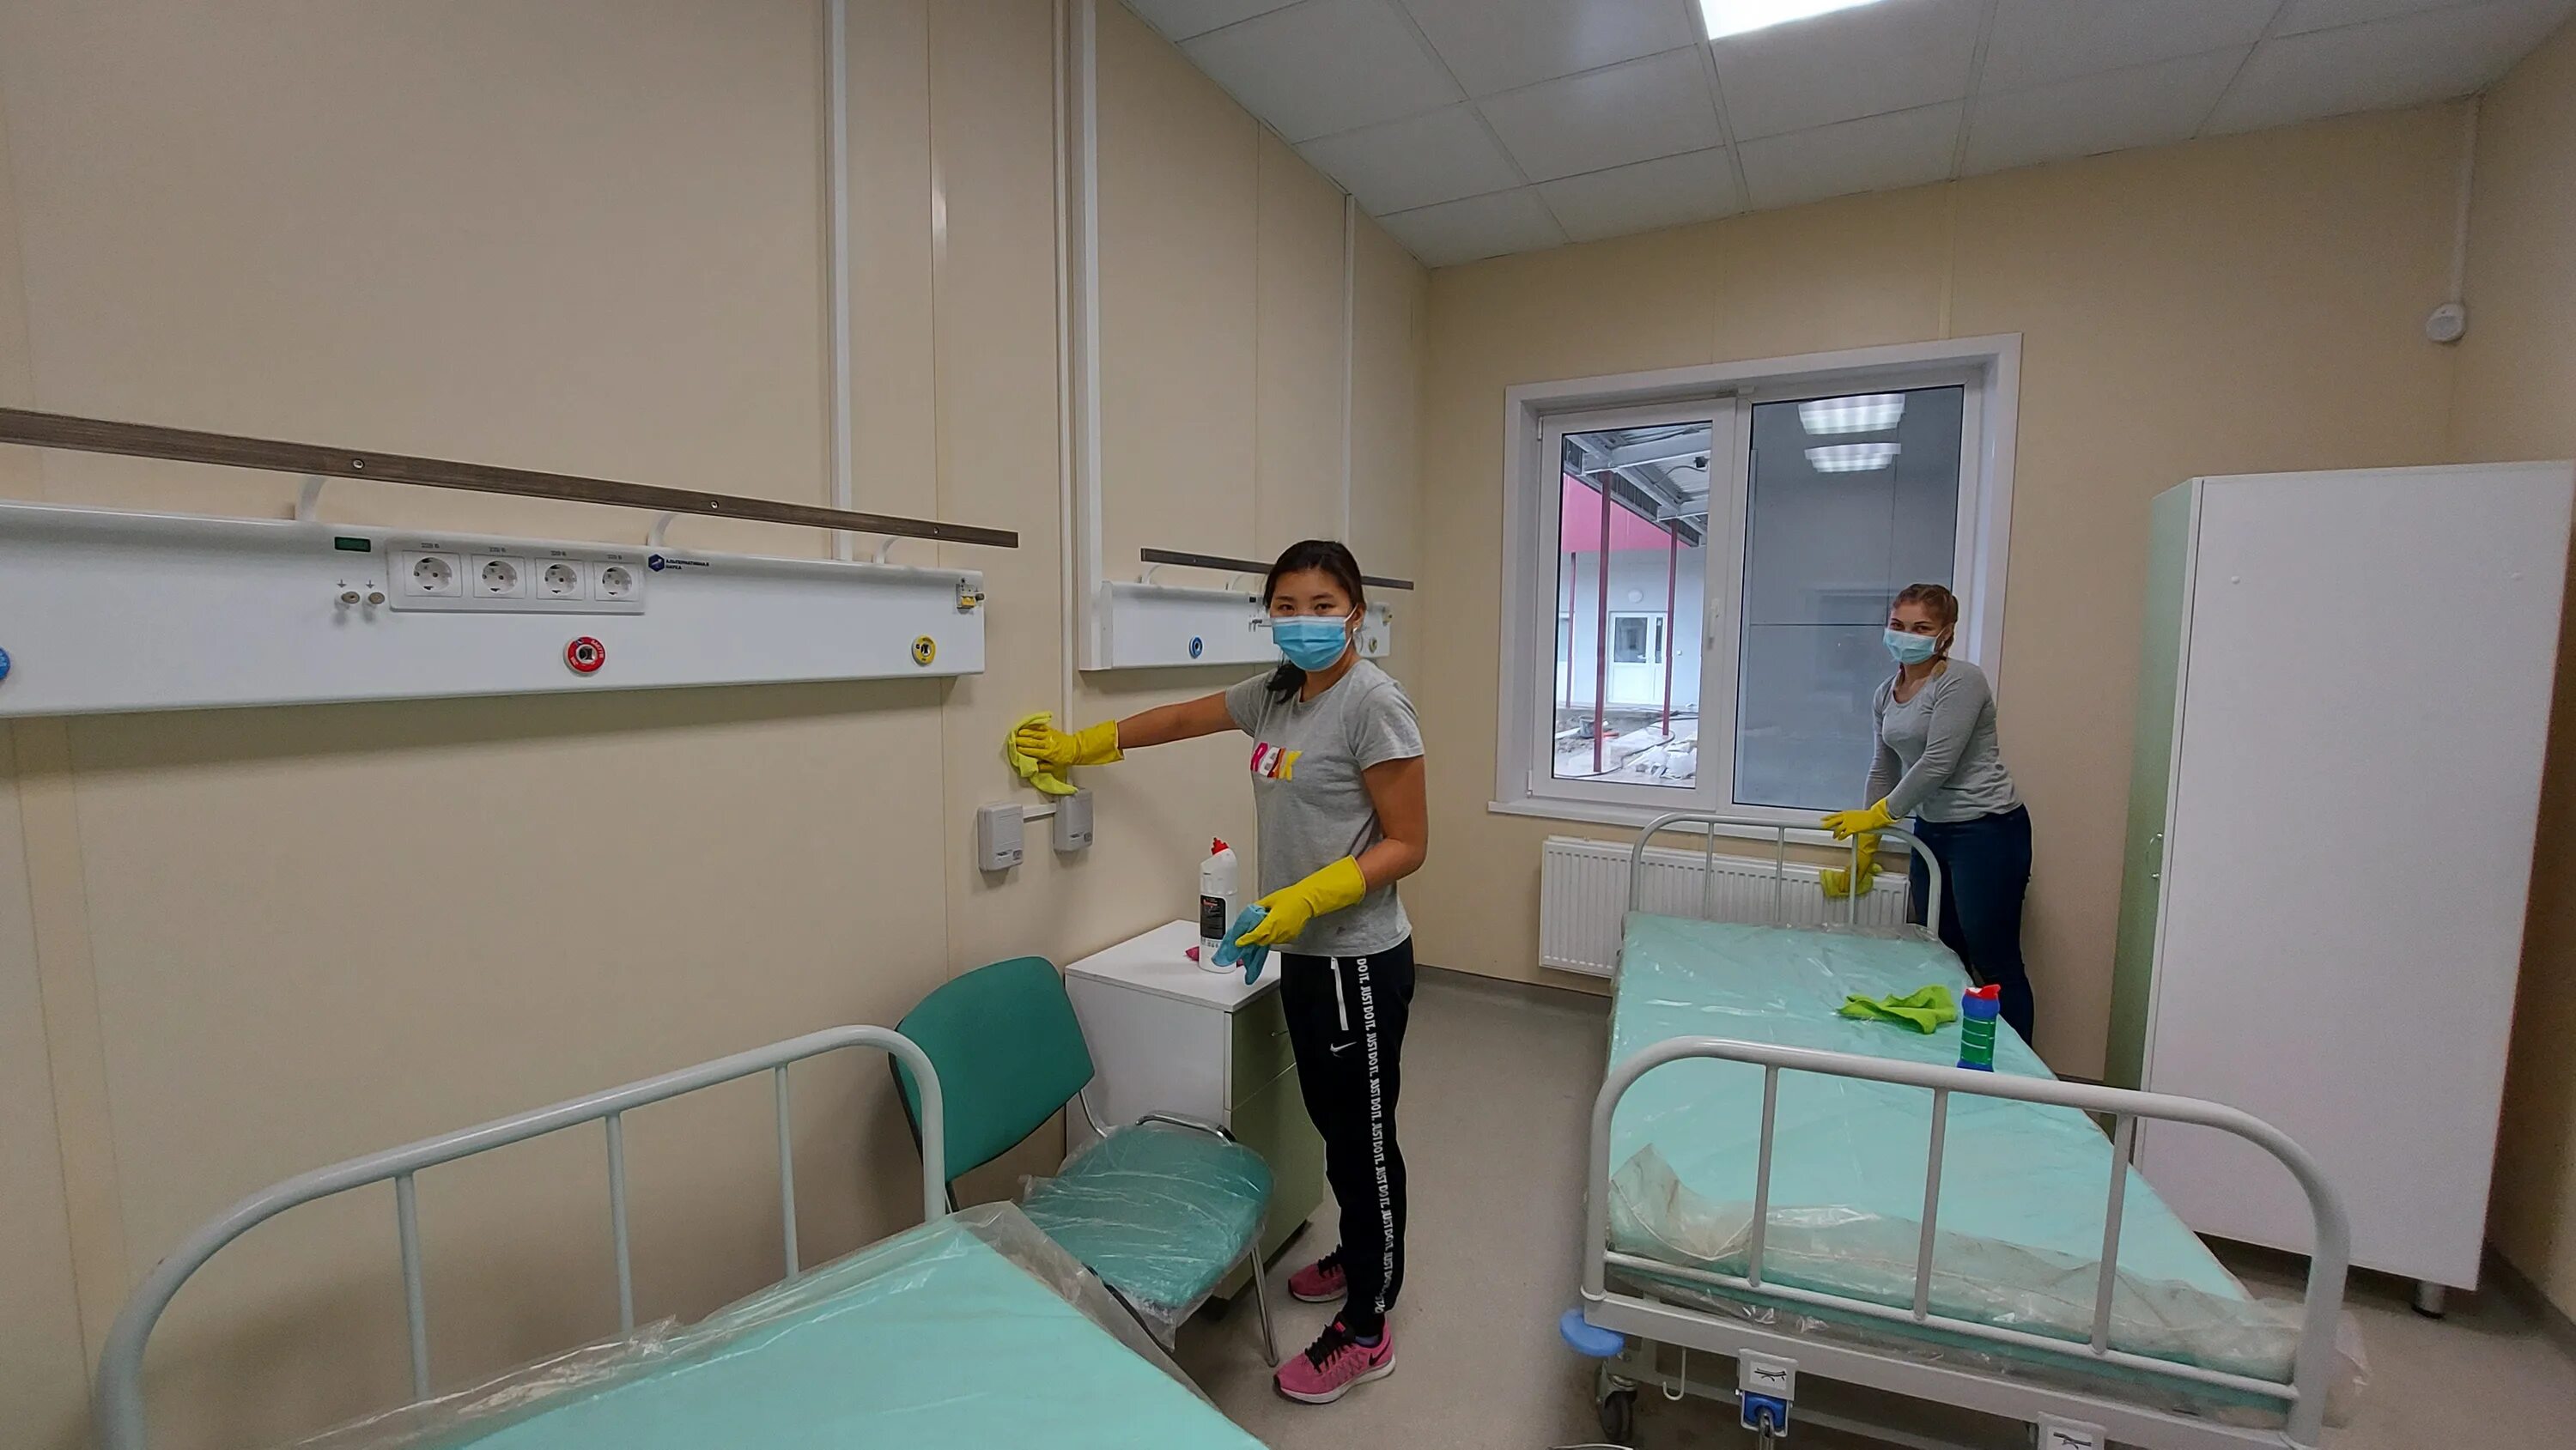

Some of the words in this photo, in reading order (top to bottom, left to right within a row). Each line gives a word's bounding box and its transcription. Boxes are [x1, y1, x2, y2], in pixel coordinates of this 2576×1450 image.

[1357, 958, 1368, 973] DO
[1360, 986, 1373, 1005] JUST
[1363, 1005, 1375, 1020] DO
[1366, 1033, 1377, 1052] JUST
[1368, 1051, 1378, 1065] DO
[1370, 1078, 1381, 1097] JUST
[1370, 1097, 1382, 1111] DO
[1371, 1123, 1383, 1140] JUST
[1373, 1140, 1384, 1154] DO
[1376, 1167, 1388, 1184] JUST
